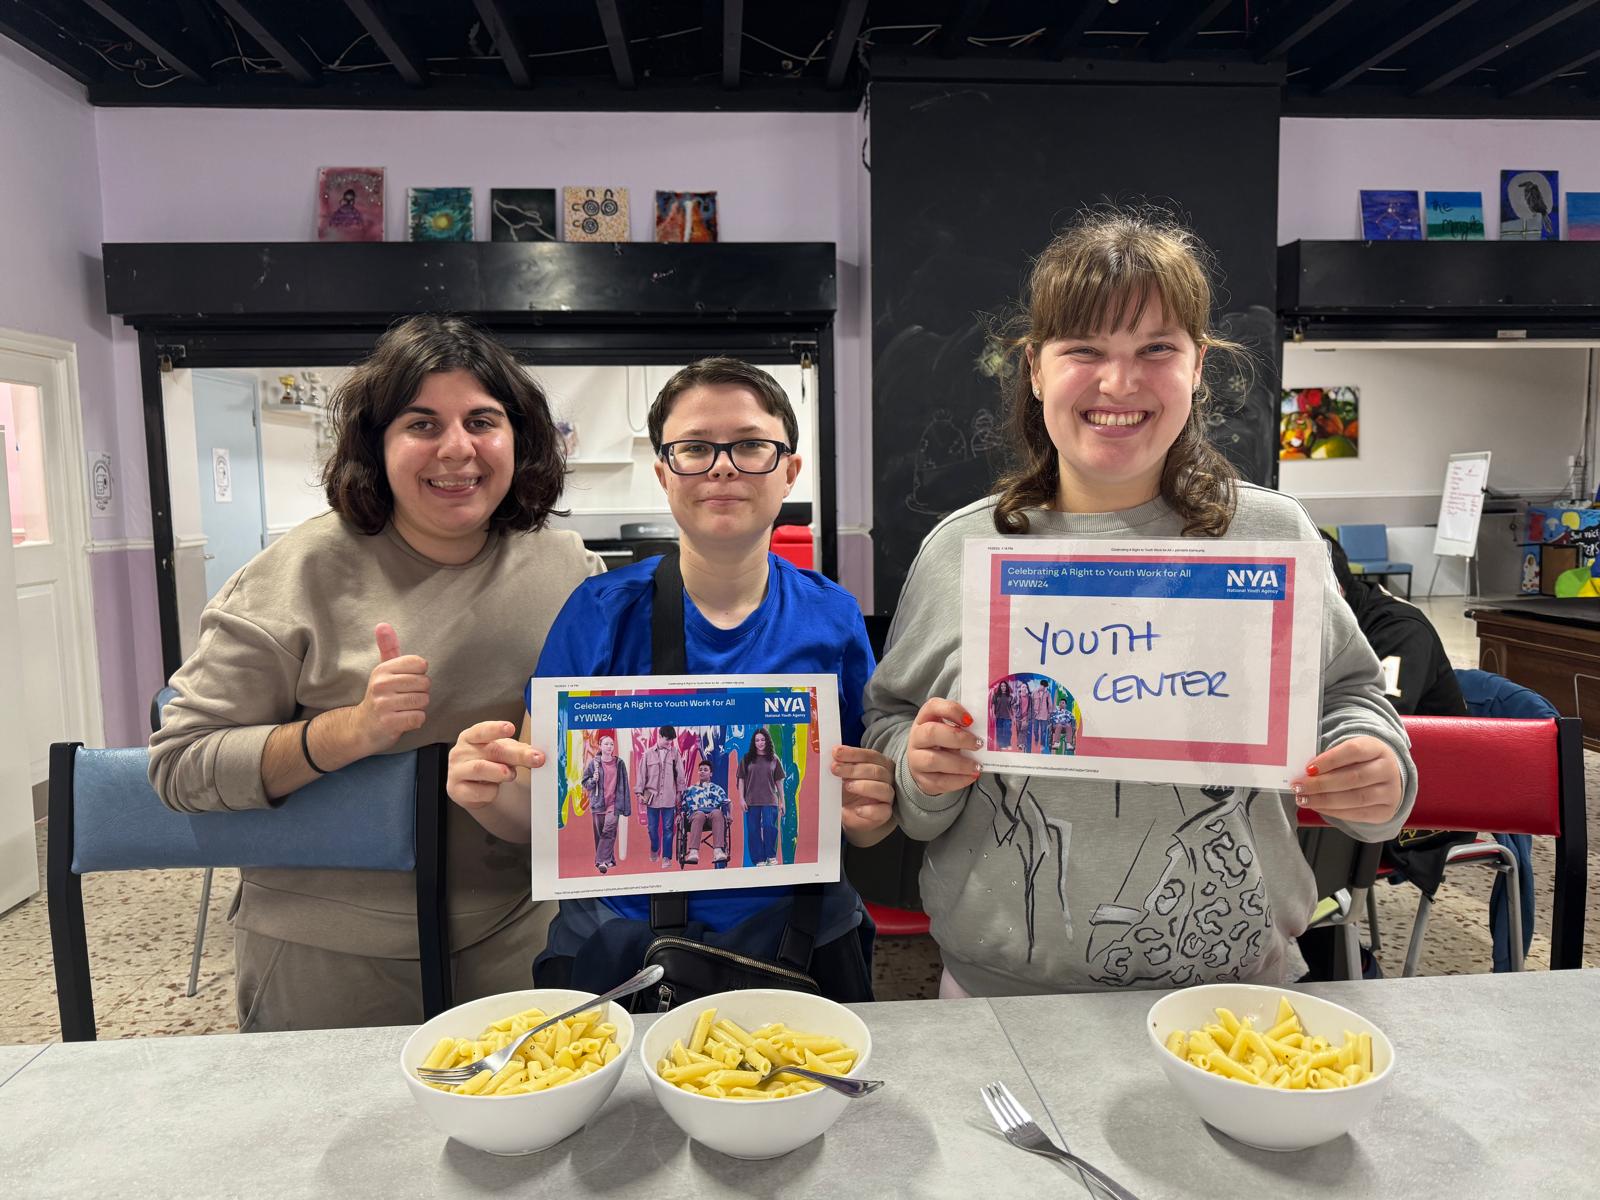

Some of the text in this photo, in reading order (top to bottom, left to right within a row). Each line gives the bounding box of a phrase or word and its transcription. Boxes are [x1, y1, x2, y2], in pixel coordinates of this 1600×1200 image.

[1007, 567, 1192, 578] Celebrating A Right to Youth Work for All
[1227, 569, 1279, 587] NYA
[1007, 579, 1049, 588] #YWW24
[1024, 621, 1162, 665] YOUTH
[1093, 670, 1230, 704] CENTER
[573, 701, 622, 711] Celebrating
[623, 701, 630, 709] A
[631, 700, 653, 710] Right
[664, 699, 688, 708] Youth
[689, 699, 711, 707] Work
[712, 698, 724, 707] for
[725, 698, 736, 706] All
[764, 697, 806, 713] NYA
[574, 713, 613, 722] #YWW24
